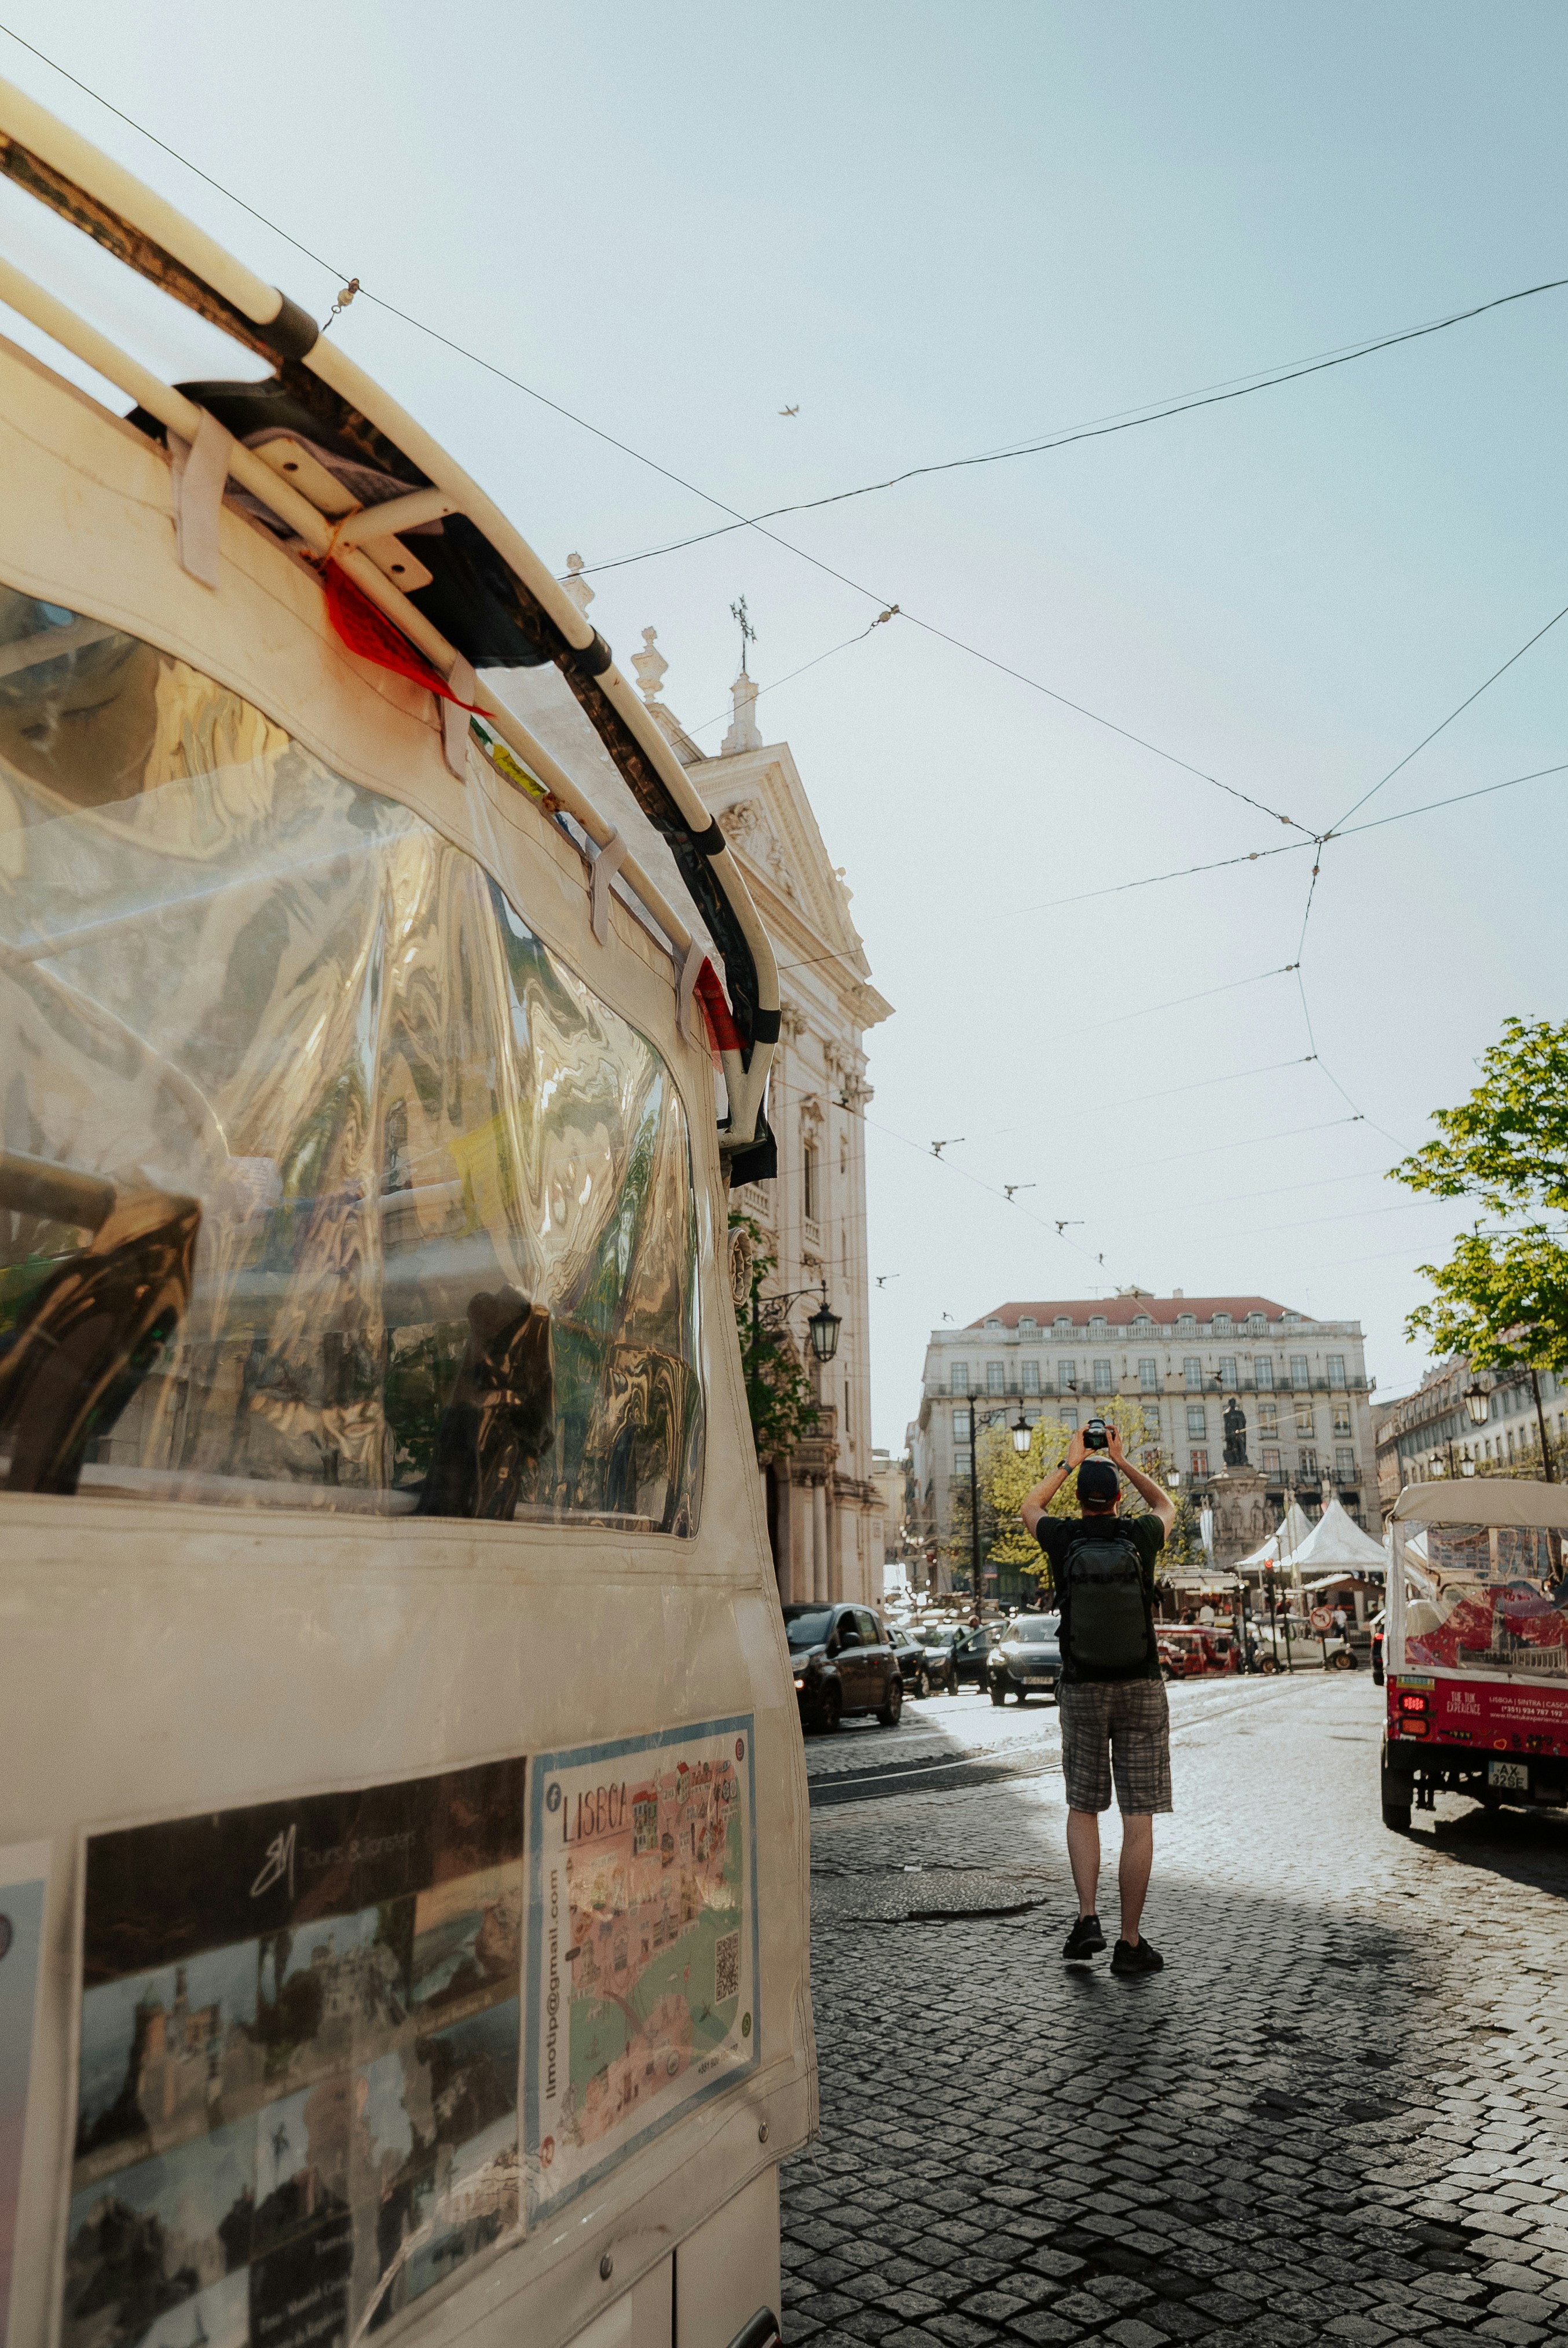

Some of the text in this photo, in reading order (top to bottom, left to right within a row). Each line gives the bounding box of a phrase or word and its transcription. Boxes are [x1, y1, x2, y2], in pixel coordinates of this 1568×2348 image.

[1489, 1696, 1513, 1704] LISBOA
[1517, 1698, 1542, 1707] SINTRA
[1447, 1701, 1481, 1716] EXPERIENCE
[1522, 1707, 1536, 1715] 934
[1500, 1764, 1518, 1777] AX
[563, 1782, 627, 1843] LISBOA
